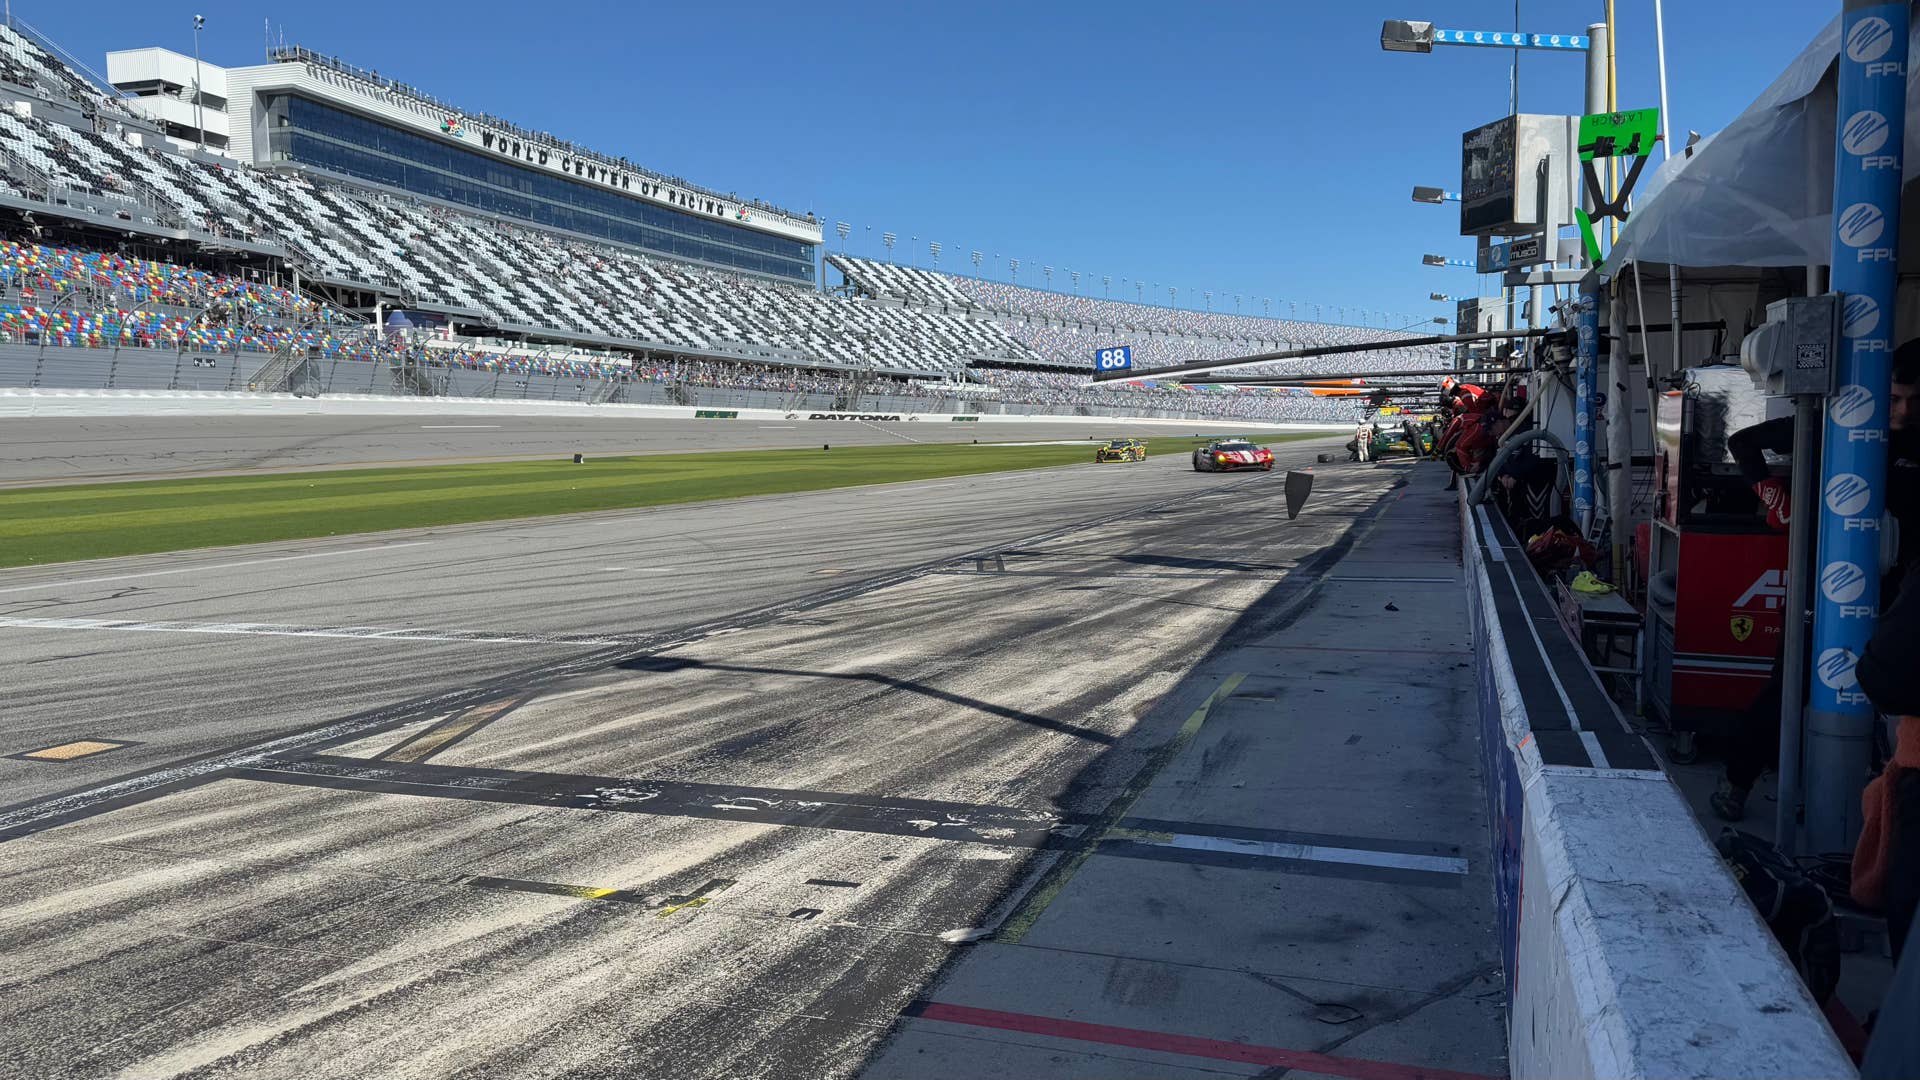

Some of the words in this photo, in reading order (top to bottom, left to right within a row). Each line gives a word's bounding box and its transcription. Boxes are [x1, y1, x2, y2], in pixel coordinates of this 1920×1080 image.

[1866, 62, 1906, 78] FPL
[1862, 156, 1901, 171] FPL
[483, 130, 548, 165] WORLD
[562, 156, 630, 190] CENTER
[642, 182, 659, 197] OF
[669, 190, 724, 216] RACING
[1857, 248, 1897, 263] FPL
[1853, 339, 1892, 352] FPL
[1101, 349, 1126, 369] 88
[808, 413, 901, 422] DAYTONA
[1848, 429, 1888, 442] FPL
[1840, 605, 1879, 618] FPL
[1836, 692, 1871, 705] FP
